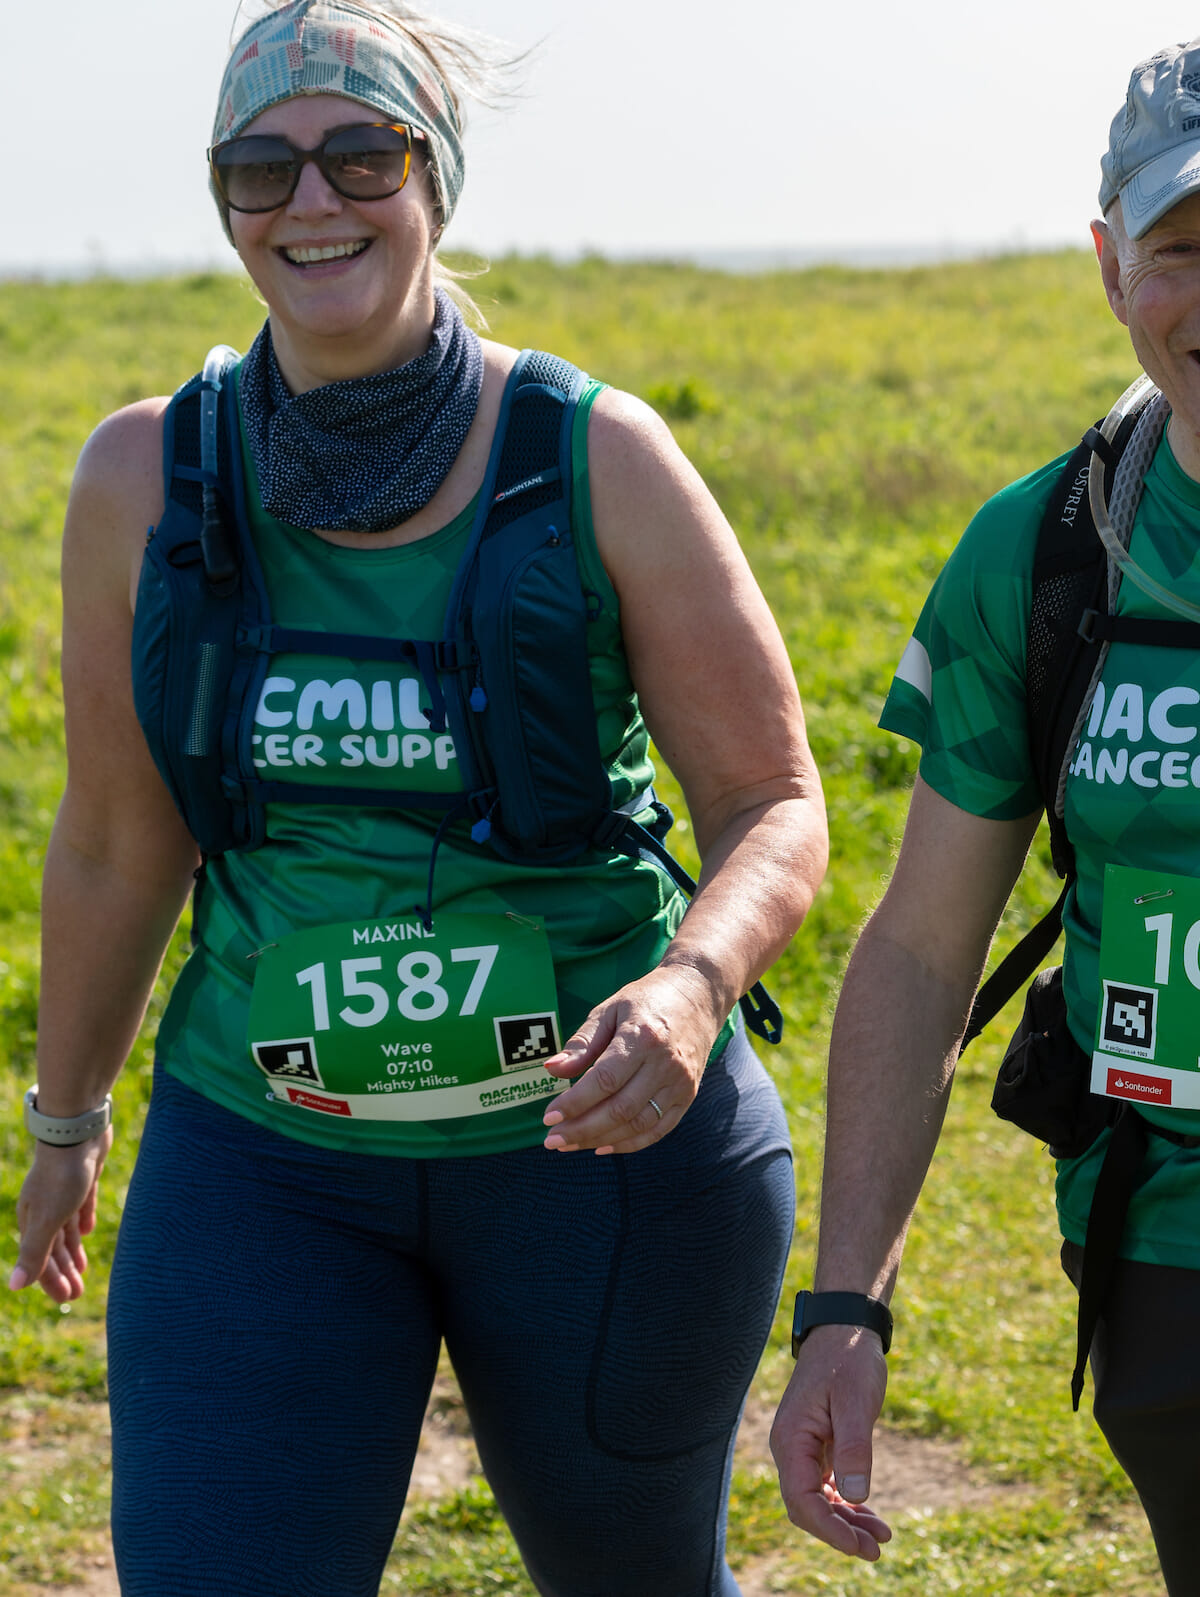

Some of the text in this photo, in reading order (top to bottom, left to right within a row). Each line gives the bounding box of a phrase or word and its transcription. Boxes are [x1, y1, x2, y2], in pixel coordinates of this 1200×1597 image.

[505, 476, 543, 496] MONTANE
[1061, 466, 1090, 528] OSPREY
[295, 944, 500, 1032] 1587
[380, 1041, 433, 1058] Wave
[386, 1059, 434, 1077] 07:10
[366, 1074, 459, 1093] Mighty Hikes
[479, 1076, 559, 1103] MACMILLAN
[1124, 1080, 1163, 1095] Santander
[482, 1095, 516, 1108] CANCER
